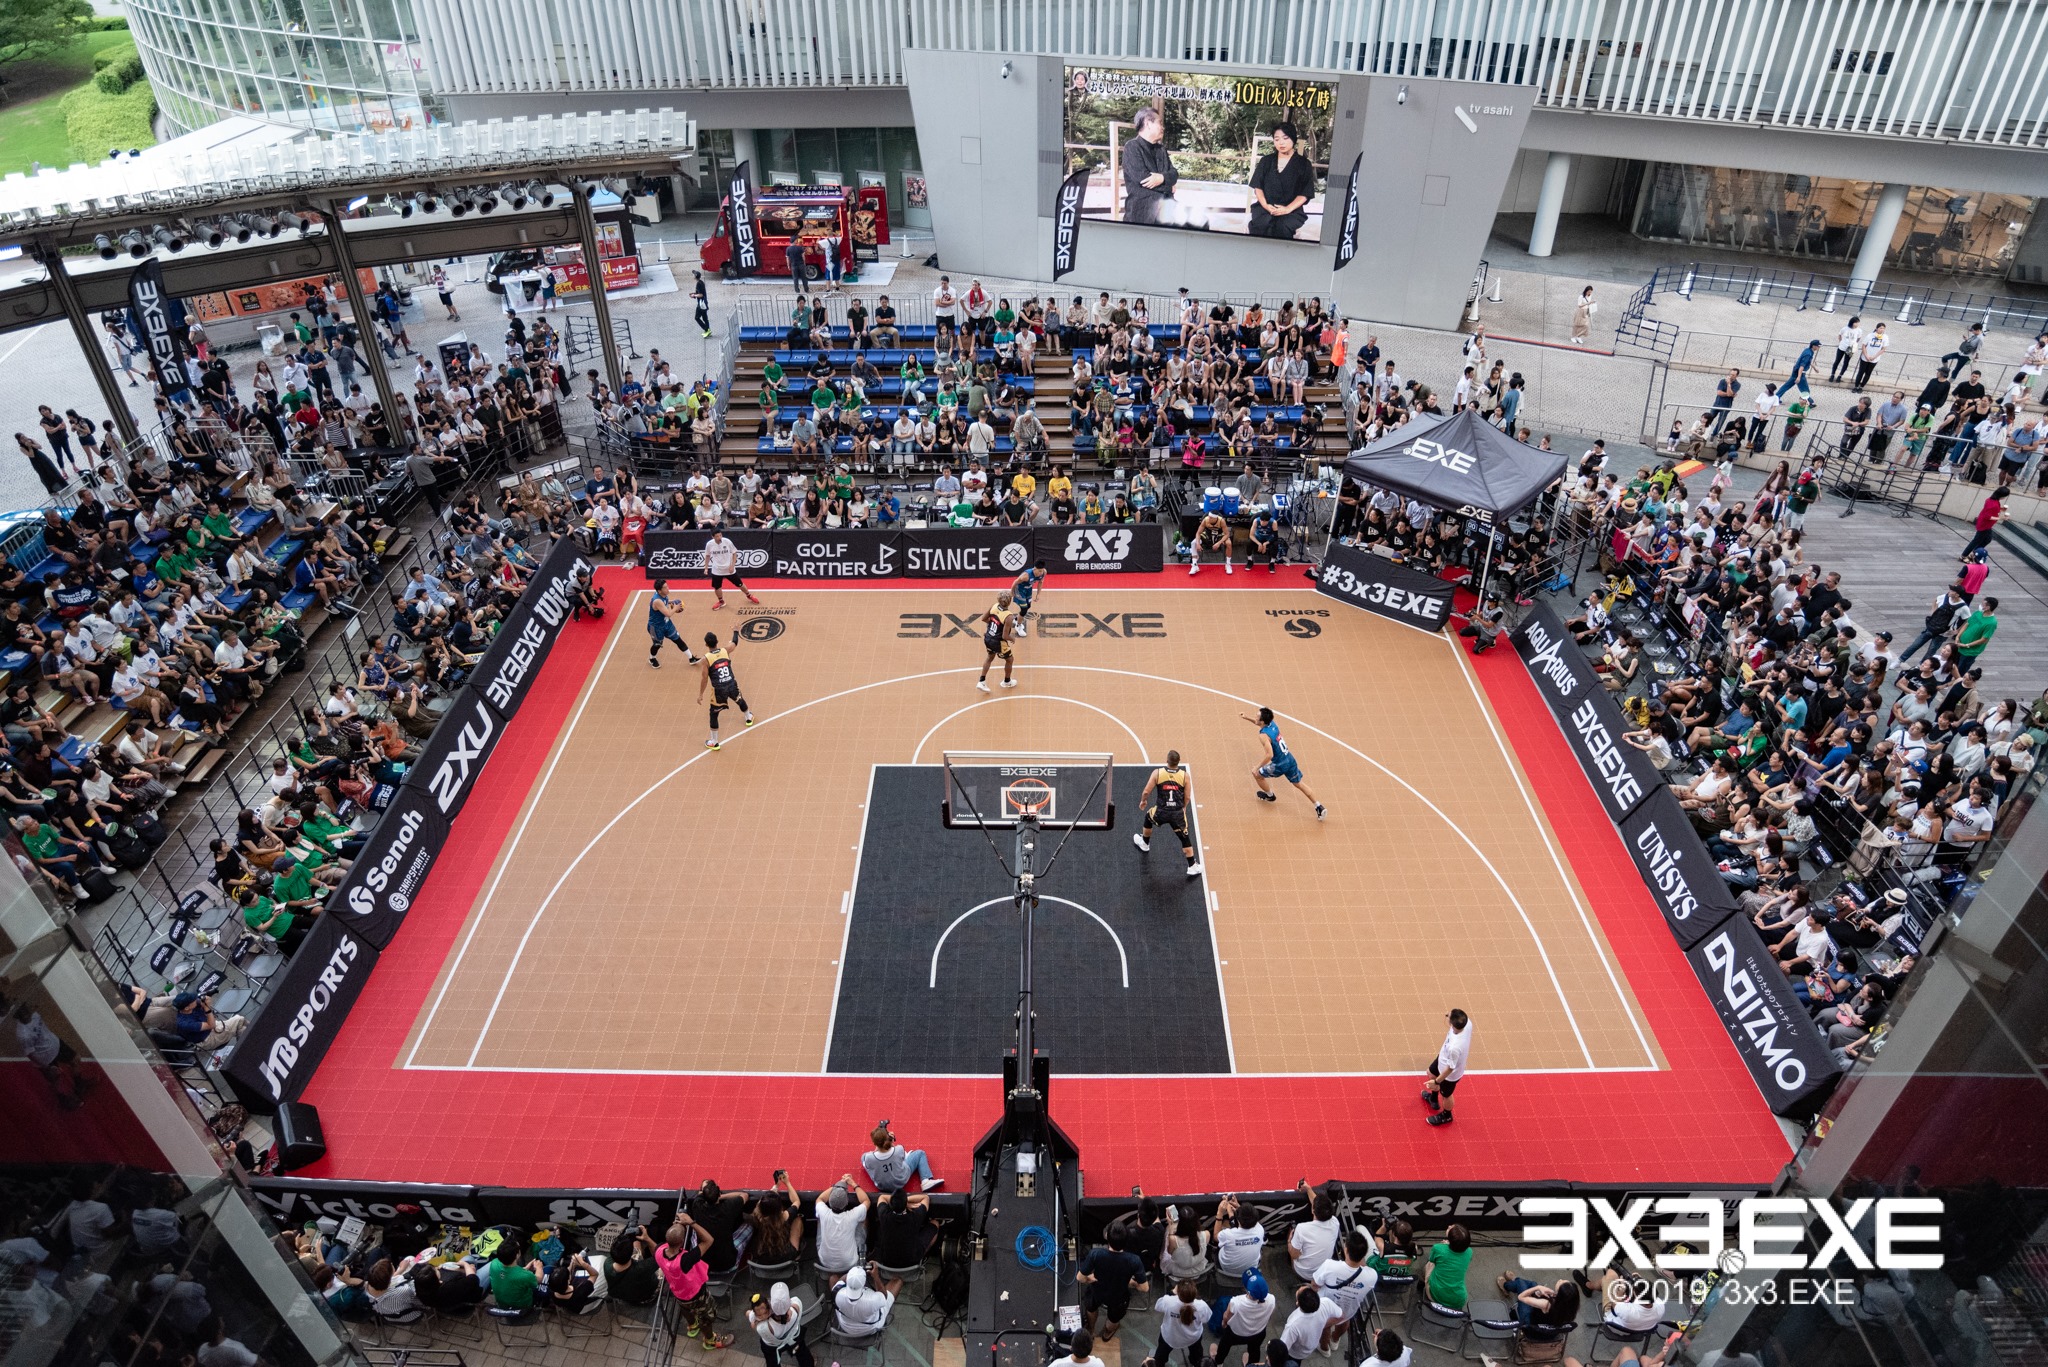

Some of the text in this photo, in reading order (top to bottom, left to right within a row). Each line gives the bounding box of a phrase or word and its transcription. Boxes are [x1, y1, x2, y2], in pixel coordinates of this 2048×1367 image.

[1469, 103, 1513, 116] tv asahi
[797, 543, 848, 558] GOLF
[908, 547, 991, 571] STANCE
[776, 560, 867, 576] PARTNER
[1075, 562, 1122, 571] FIBA ENDORSED
[1322, 564, 1444, 620] #3x3EXE
[1265, 609, 1331, 618] Senoh
[1525, 621, 1578, 696] AQUARIUS
[717, 666, 730, 679] 39
[428, 700, 494, 814] 2XU
[366, 810, 424, 893] Senoh
[1746, 956, 1799, 1037] 日本人のためのプロテイン
[259, 934, 358, 1100] JTB SPORTS
[882, 1163, 893, 1173] 31
[254, 1191, 477, 1223] Victoia
